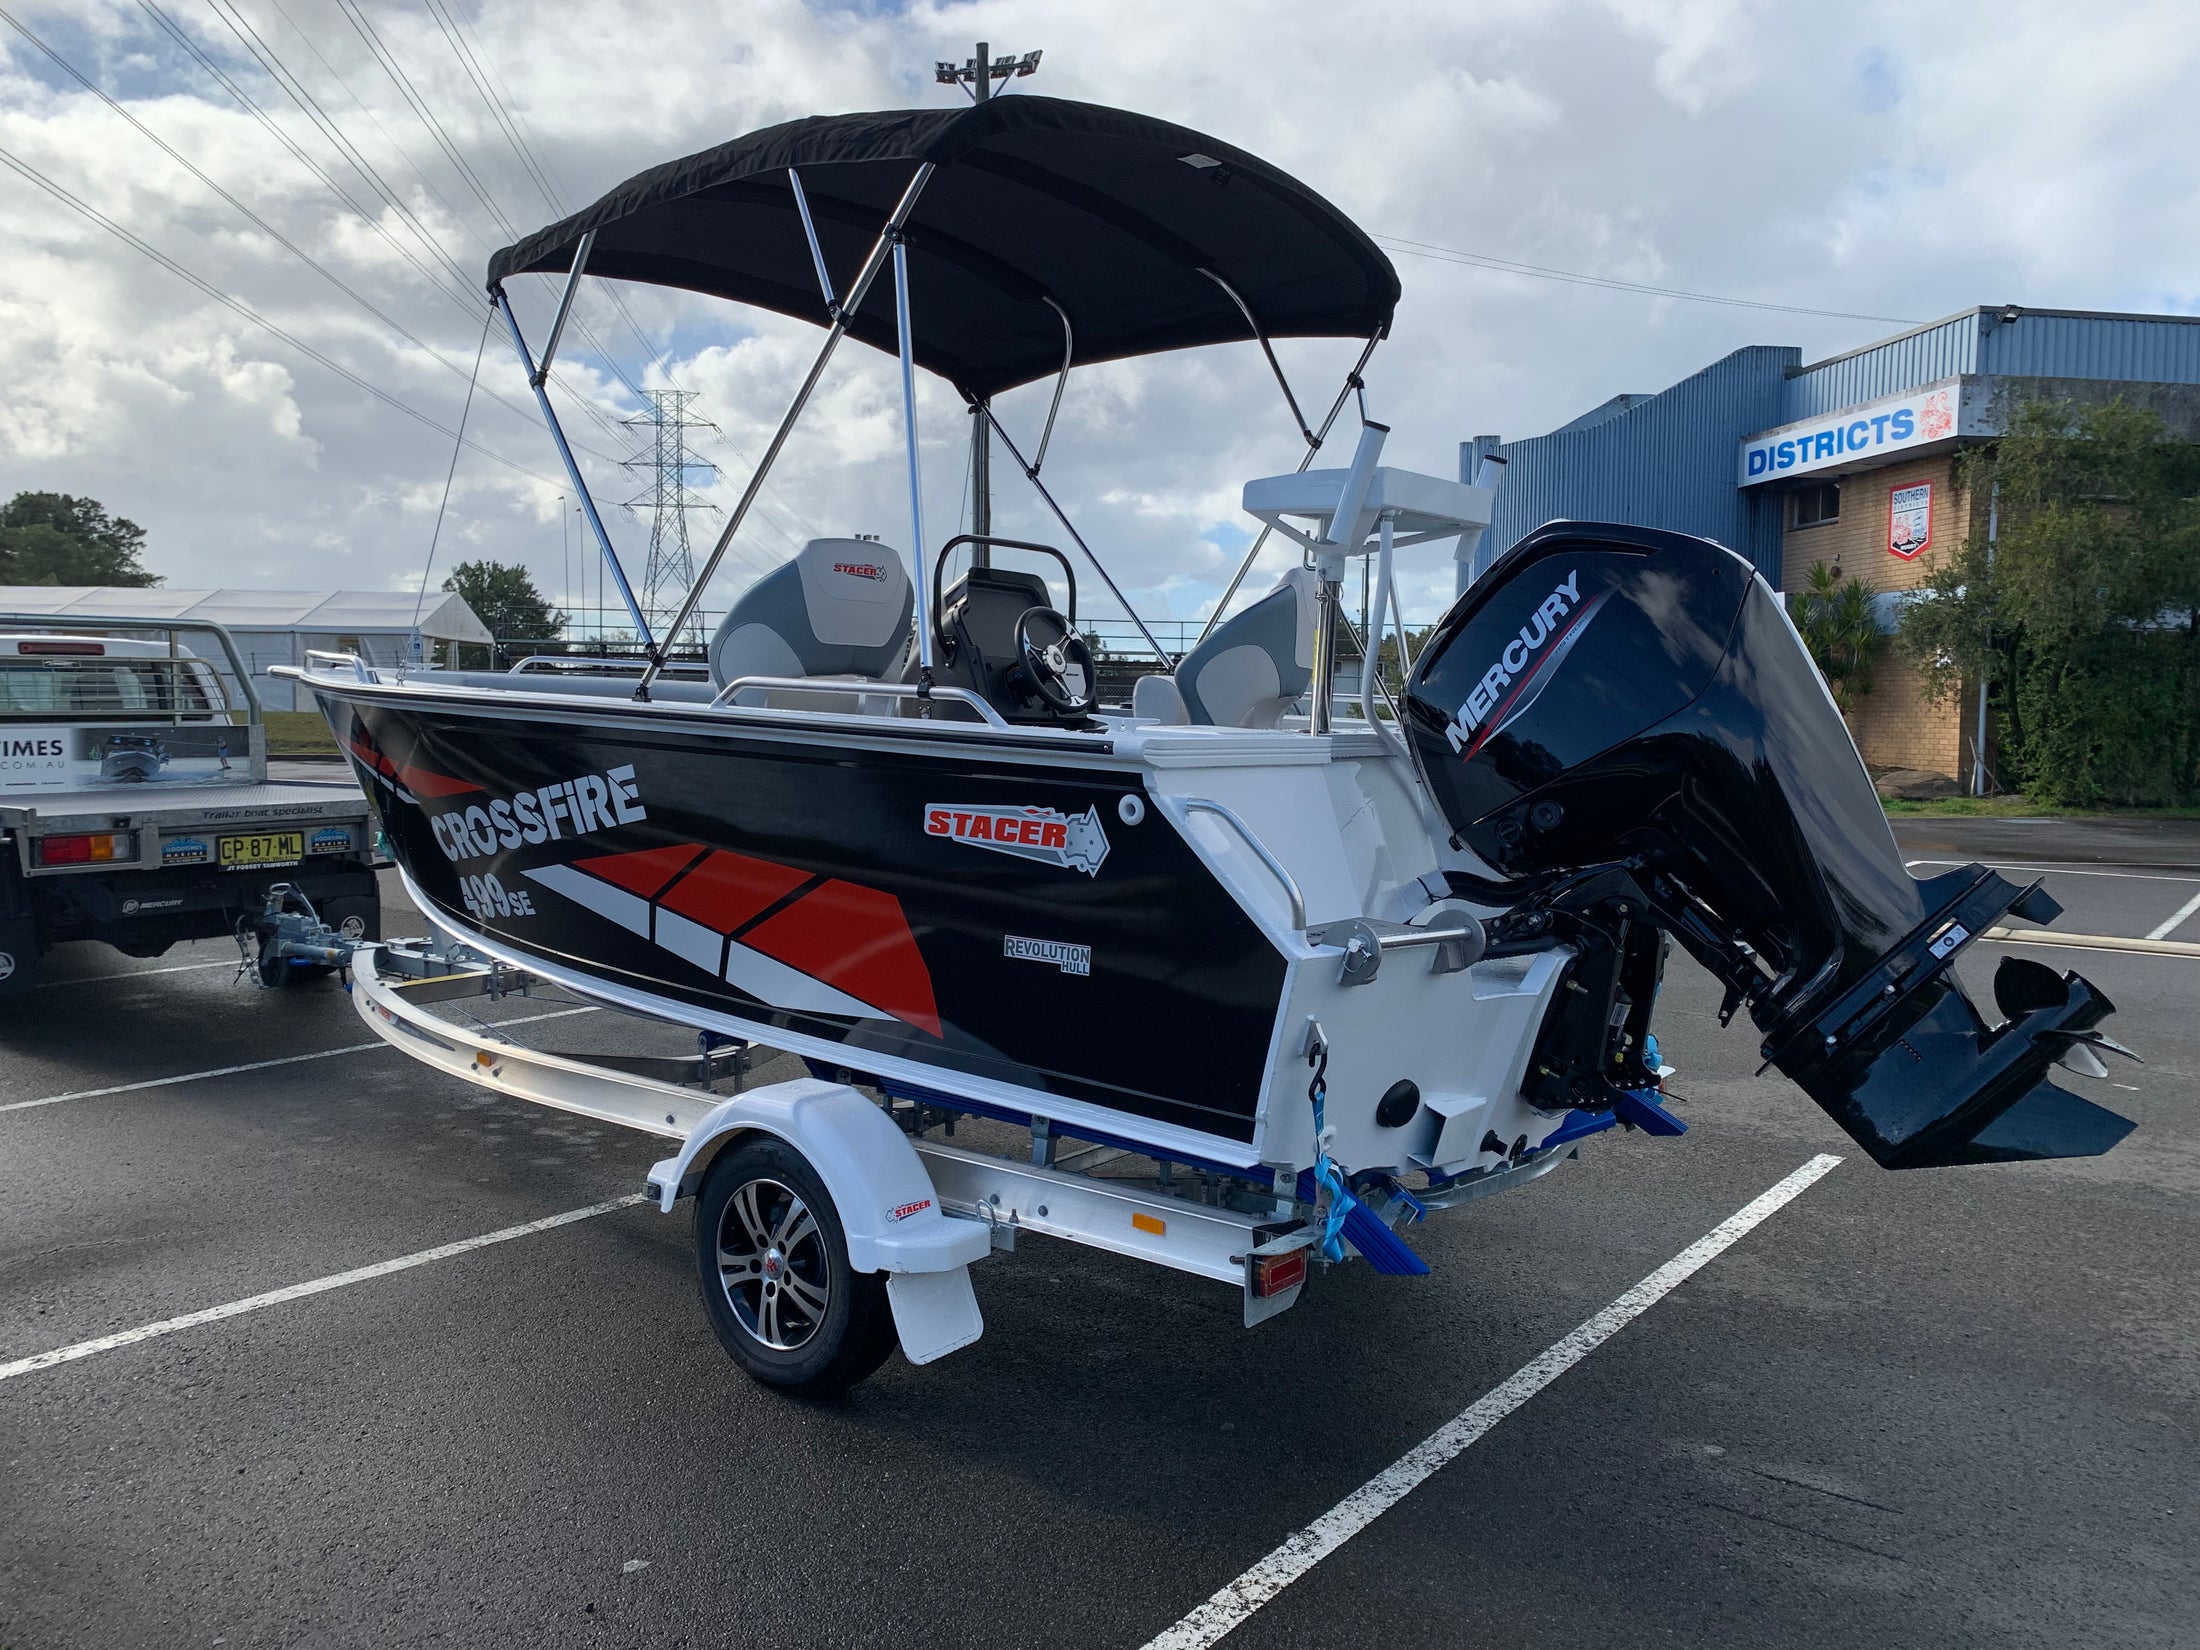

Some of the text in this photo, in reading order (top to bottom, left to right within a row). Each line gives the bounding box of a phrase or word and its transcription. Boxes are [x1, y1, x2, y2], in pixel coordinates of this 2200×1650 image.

[1748, 408, 1915, 476] DISTRICTS
[1893, 487, 1928, 505] SOUTHERN
[833, 564, 877, 576] STACER
[1444, 569, 1581, 754] MERCURY
[0, 740, 63, 757] IMES
[203, 806, 324, 820] Trailer boat specialist
[430, 763, 647, 862] CROSSFIRE
[928, 810, 1068, 849] STACER
[140, 899, 183, 909] MERCURY
[1004, 938, 1090, 964] REVOLUTION
[1062, 960, 1089, 975] HULL
[895, 1200, 931, 1217] STACER
